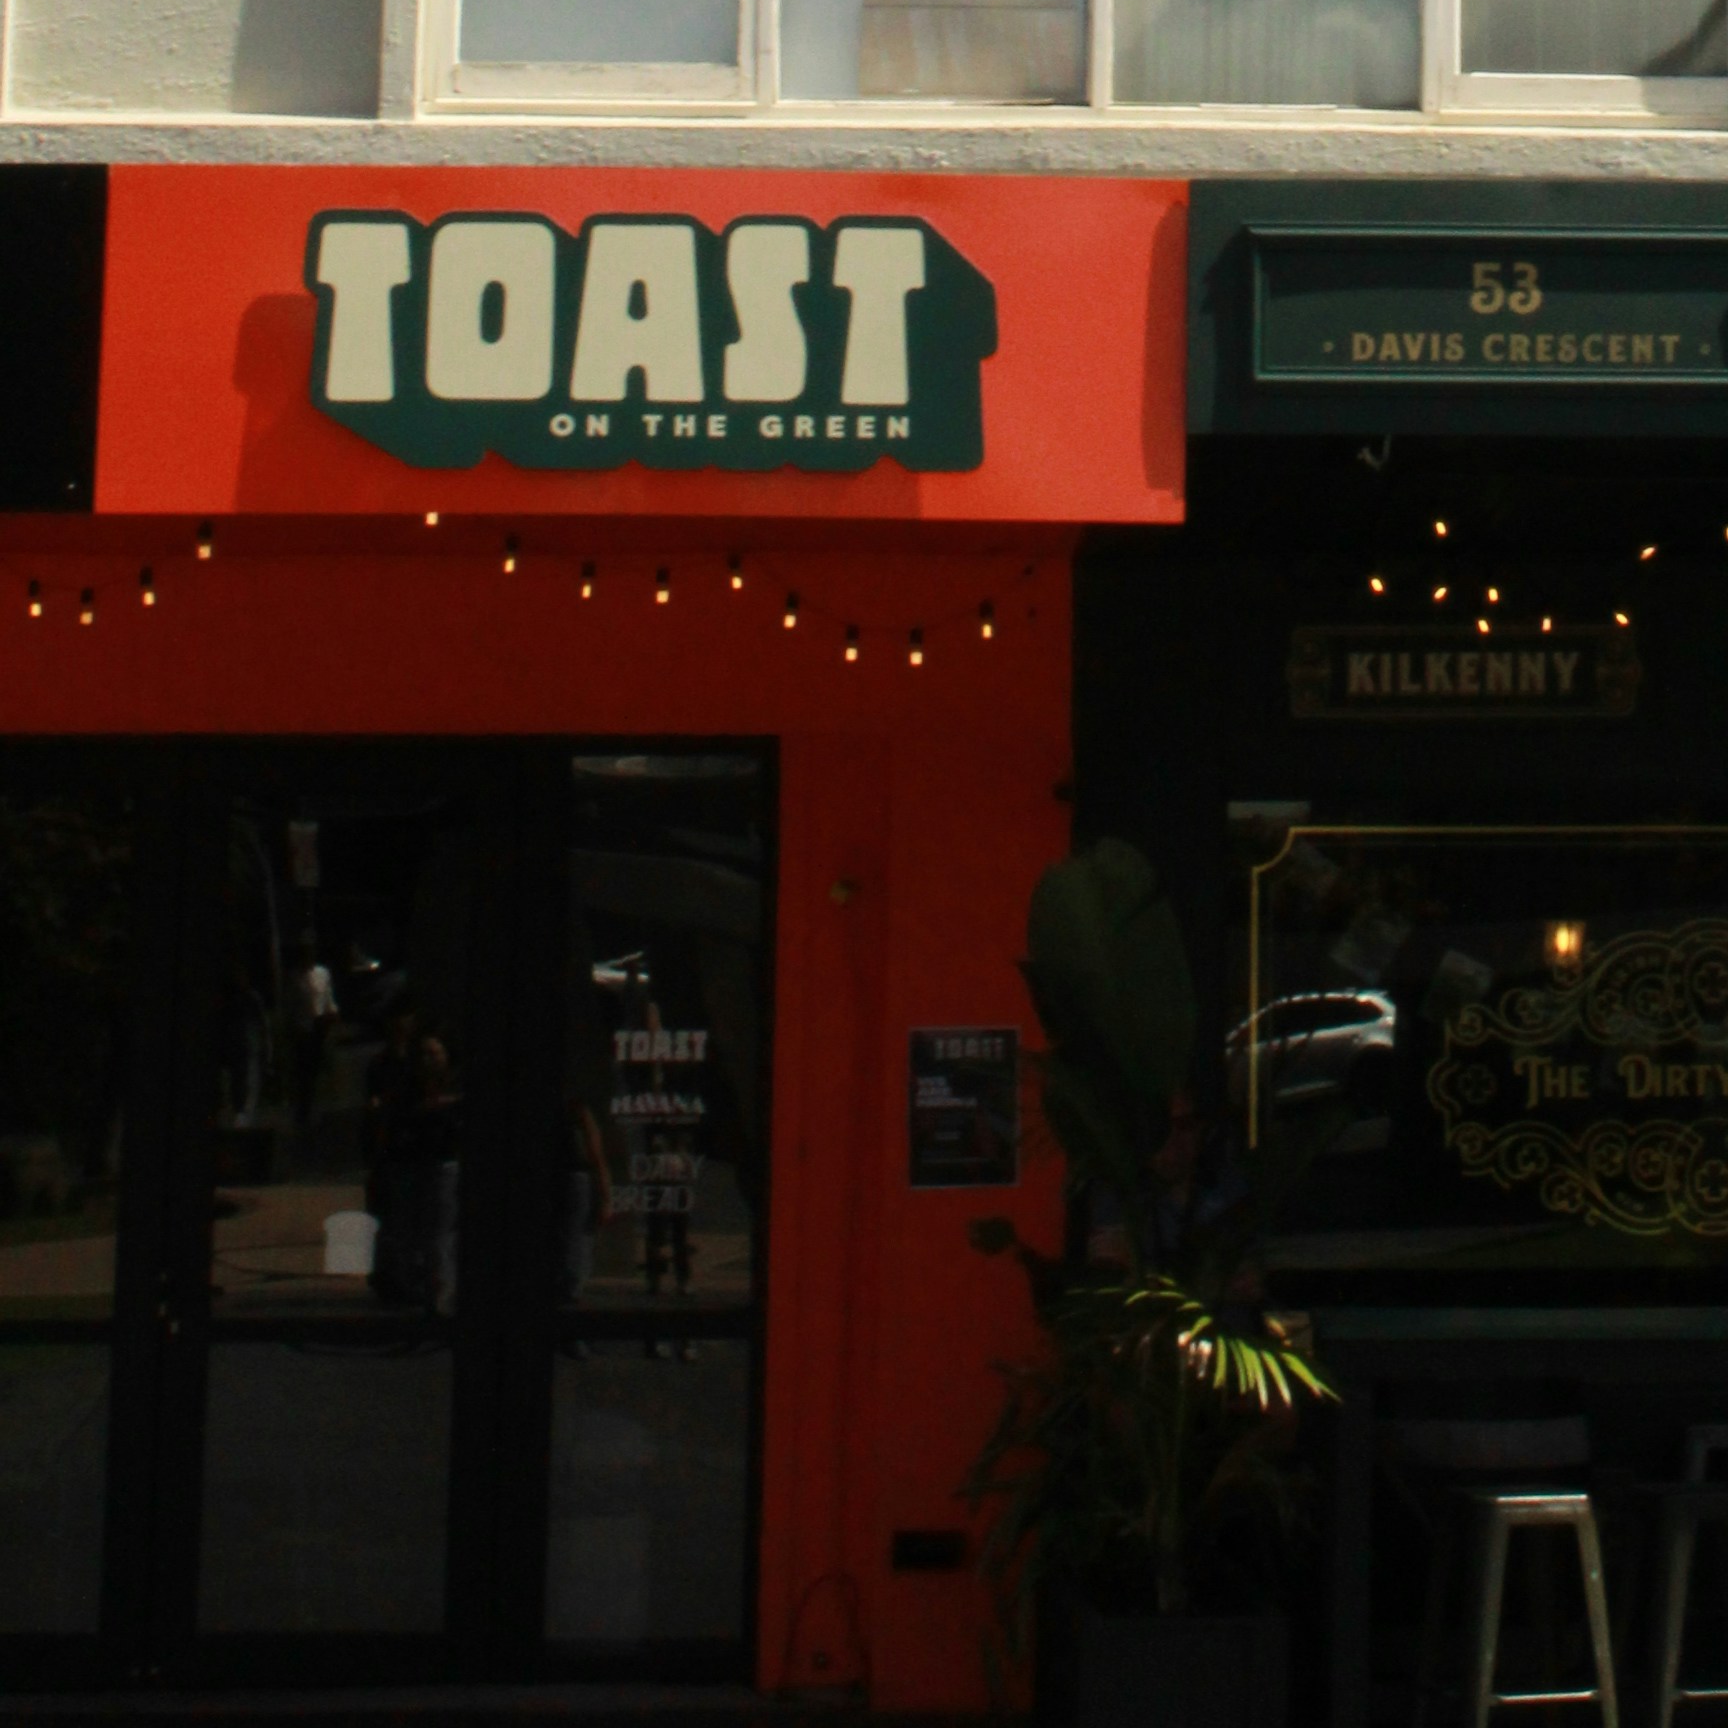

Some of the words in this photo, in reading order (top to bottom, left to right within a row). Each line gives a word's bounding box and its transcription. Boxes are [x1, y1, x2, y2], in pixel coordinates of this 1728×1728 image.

[1468, 261, 1544, 316] 53
[317, 222, 926, 405] TOAST
[1351, 331, 1466, 363] DAVIS
[1482, 333, 1681, 365] CRESCENT
[550, 413, 611, 438] ON
[643, 413, 728, 438] THE
[759, 414, 911, 440] GREEN
[1347, 651, 1583, 695] KILKENNY
